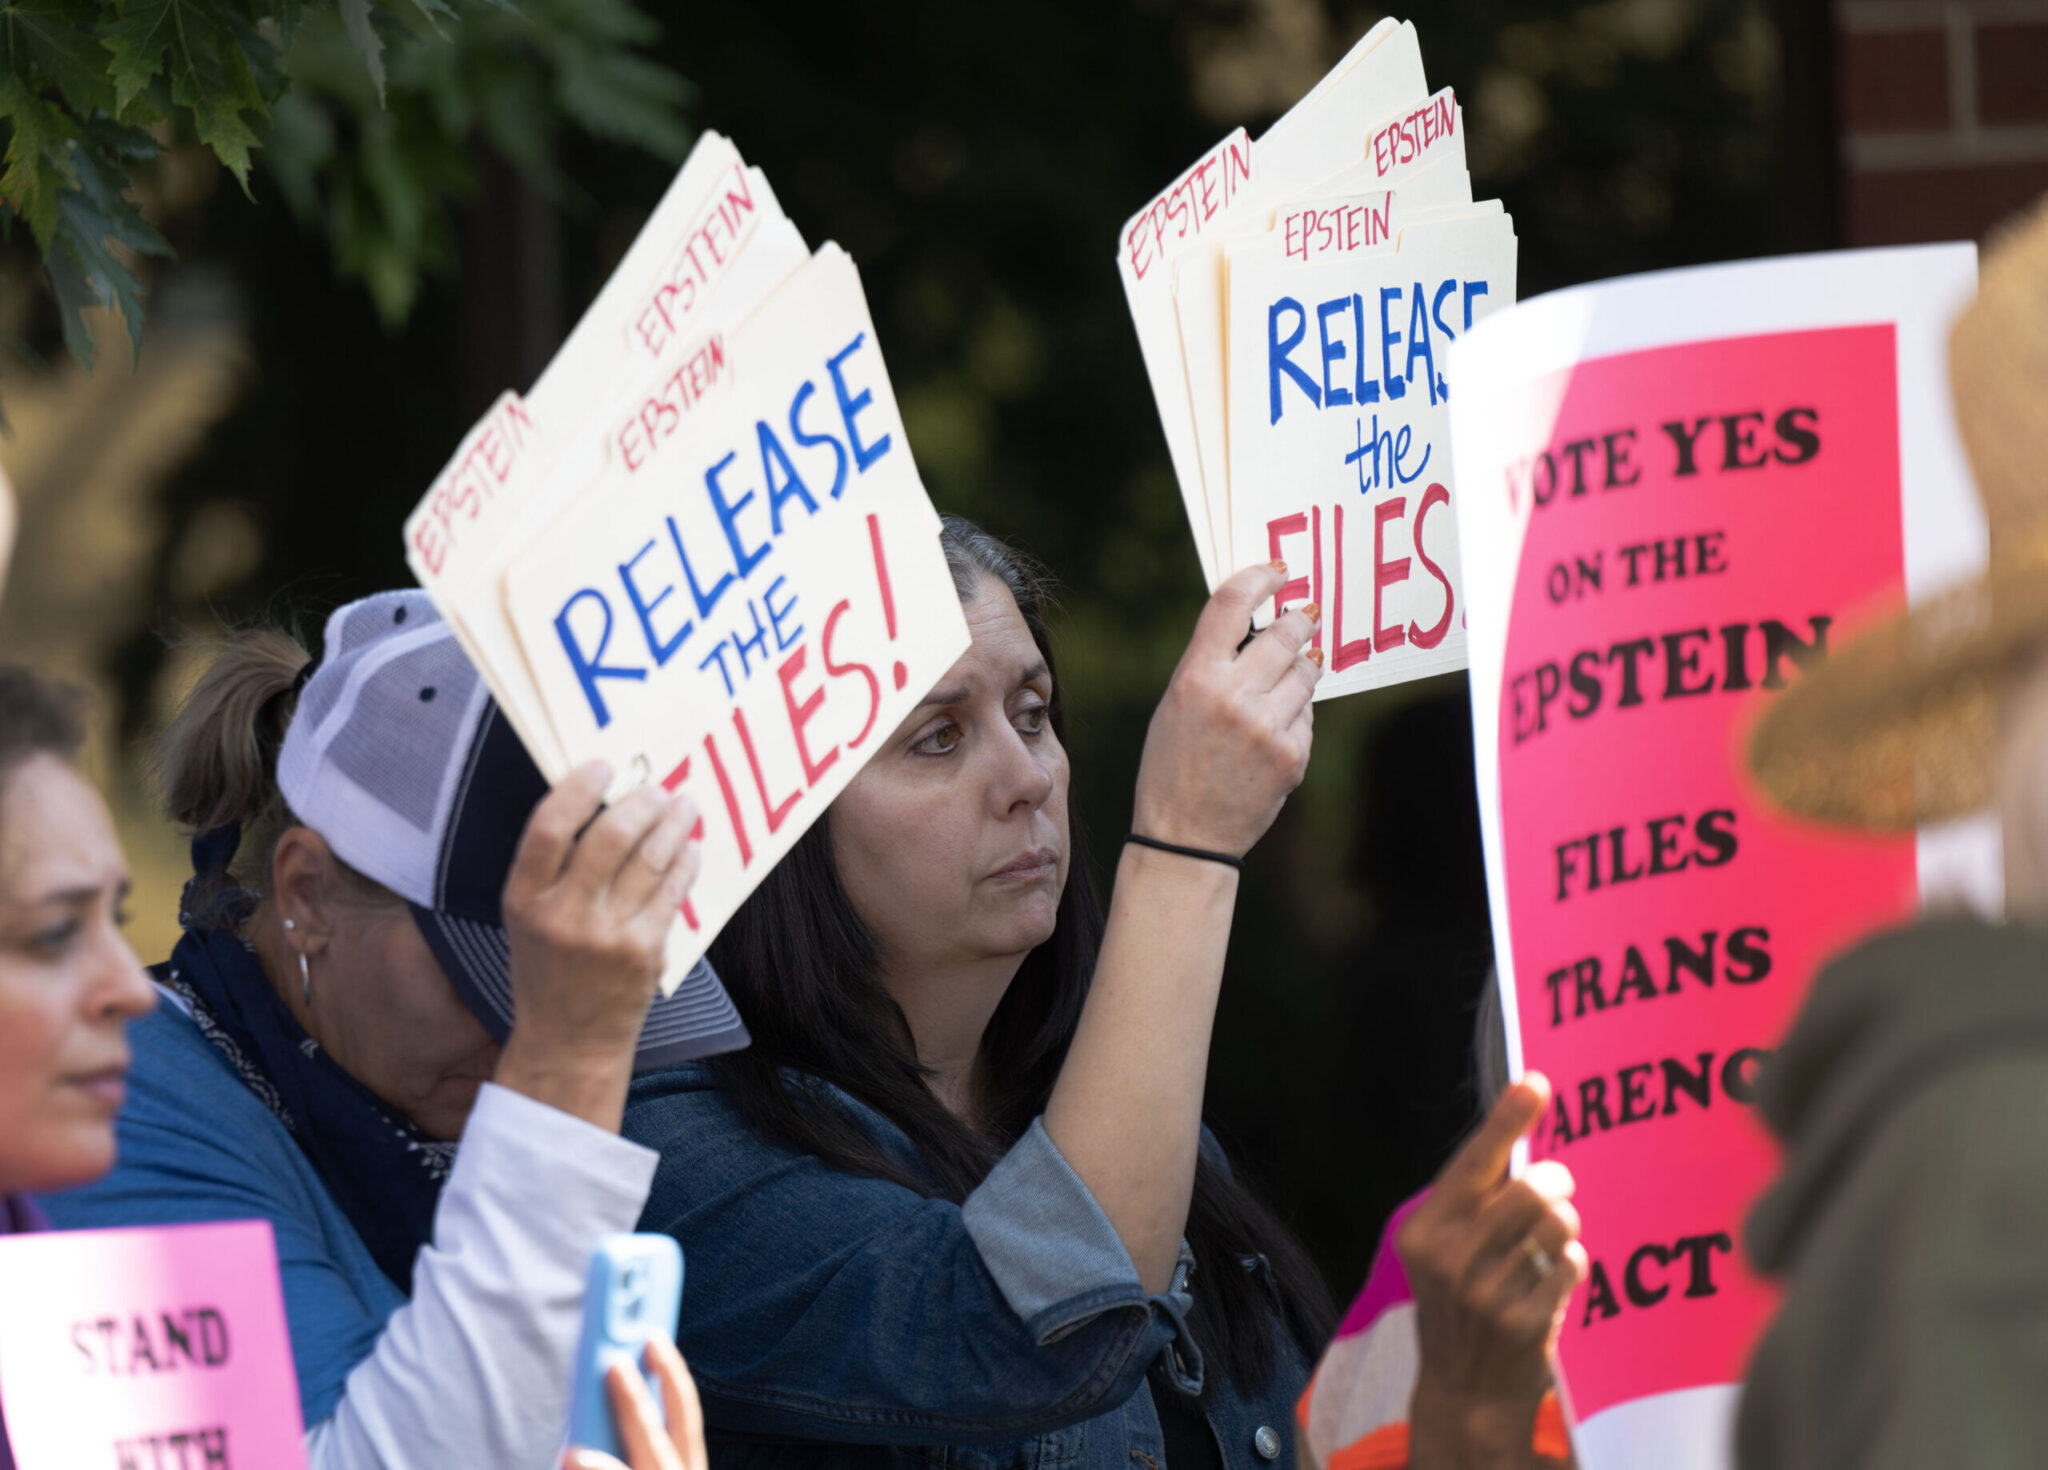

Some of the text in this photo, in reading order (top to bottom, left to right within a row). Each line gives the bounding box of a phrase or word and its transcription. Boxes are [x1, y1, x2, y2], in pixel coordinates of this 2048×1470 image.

[1373, 93, 1456, 177] EPSTEIN
[1127, 131, 1251, 280] EPSTEIN
[1284, 191, 1392, 261] EPSTEIN
[635, 162, 757, 357] EPSTEIN
[617, 333, 726, 472] EPSTEIN
[1344, 414, 1432, 495] the
[1657, 405, 1822, 478] YES
[413, 395, 535, 577] EPSTEIN
[553, 331, 892, 731] RELEASE
[1266, 482, 1469, 673] FILES
[1546, 531, 1728, 605] ON THE
[698, 574, 805, 698] THE
[1511, 615, 1833, 747] EPSTEIN
[1553, 808, 1740, 902] FILES
[1545, 926, 1774, 1029] TRANS
[1536, 1047, 1774, 1154] ARENC
[1582, 1232, 1733, 1328] ACT
[71, 1306, 231, 1376] STAND
